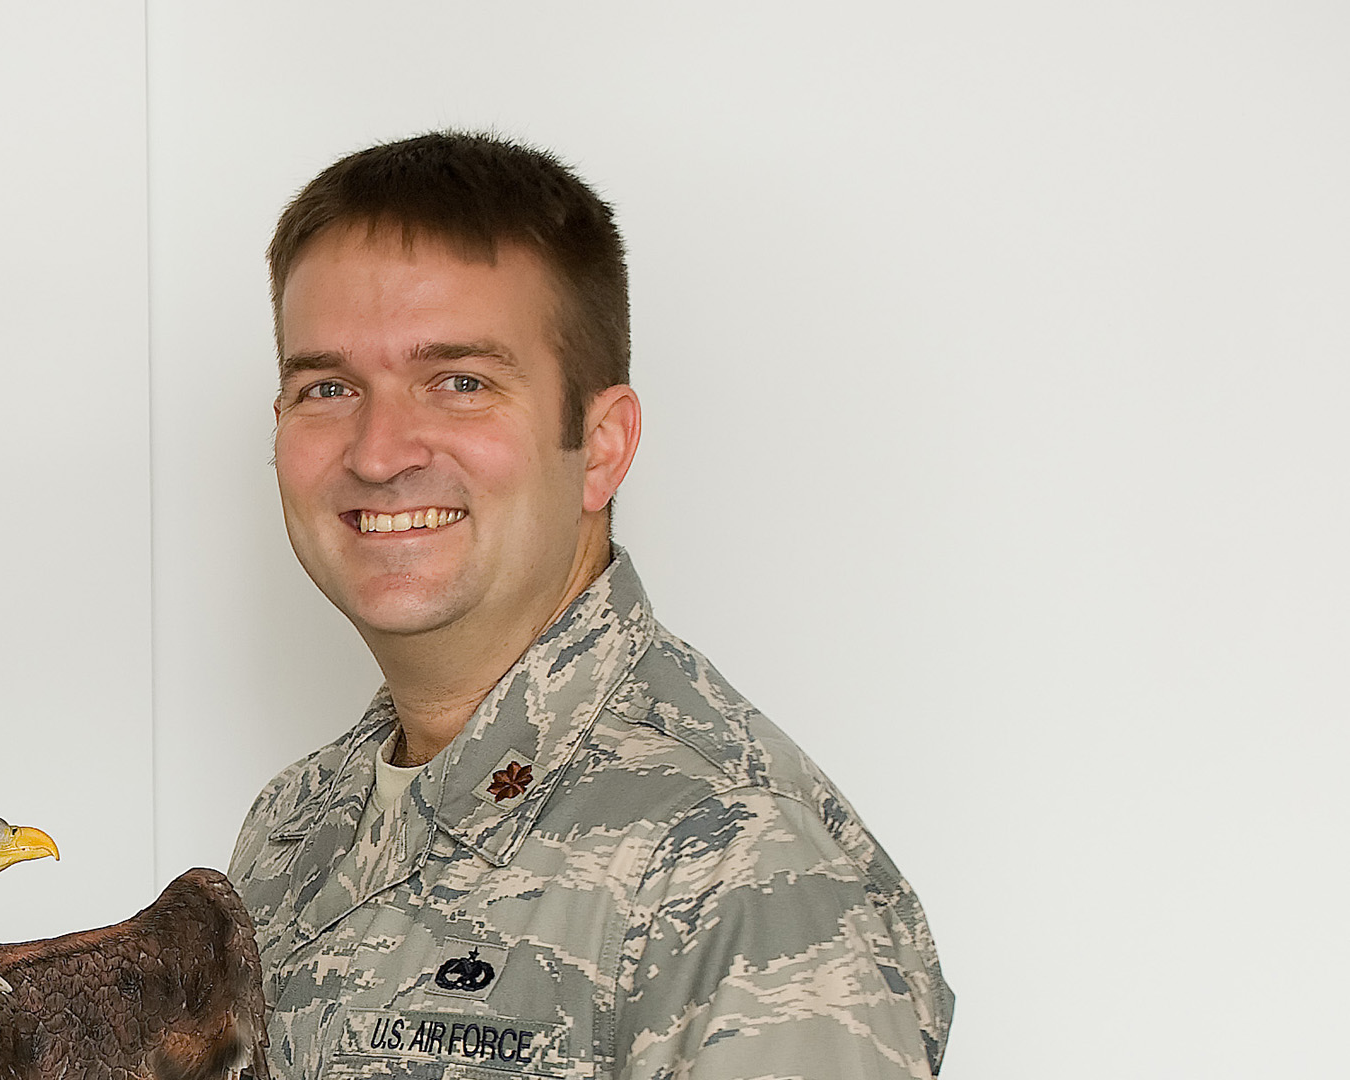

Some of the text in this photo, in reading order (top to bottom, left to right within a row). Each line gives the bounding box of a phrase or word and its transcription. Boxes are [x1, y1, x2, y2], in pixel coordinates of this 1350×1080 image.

[370, 1017, 533, 1063] U.S. AIR FORCE
